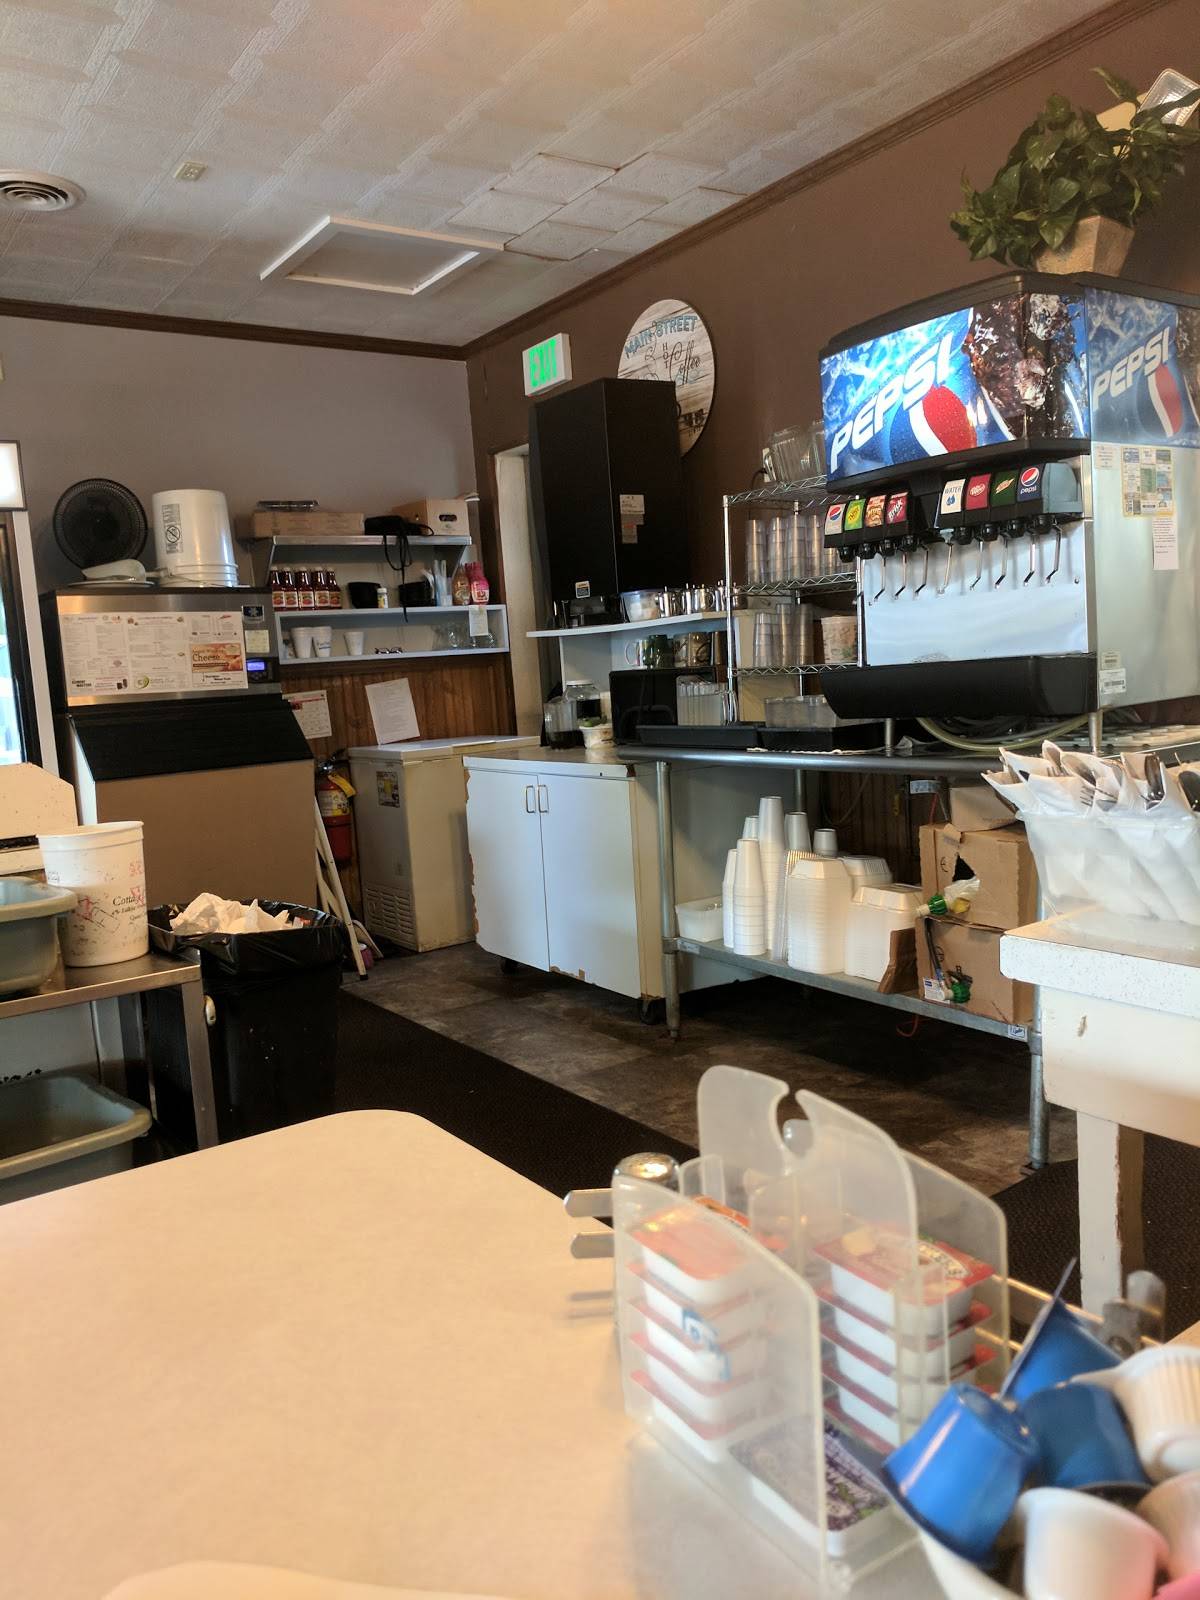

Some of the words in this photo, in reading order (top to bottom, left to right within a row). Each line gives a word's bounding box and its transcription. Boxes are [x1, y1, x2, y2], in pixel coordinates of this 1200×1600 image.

[624, 328, 655, 360] MAIN
[655, 315, 698, 339] STREET
[529, 338, 557, 387] EXIT
[670, 339, 702, 385] Coffee
[1093, 327, 1171, 411] PEPSI
[830, 333, 953, 474] PEPSI
[944, 486, 962, 495] WATER
[1020, 485, 1037, 495] pepsi
